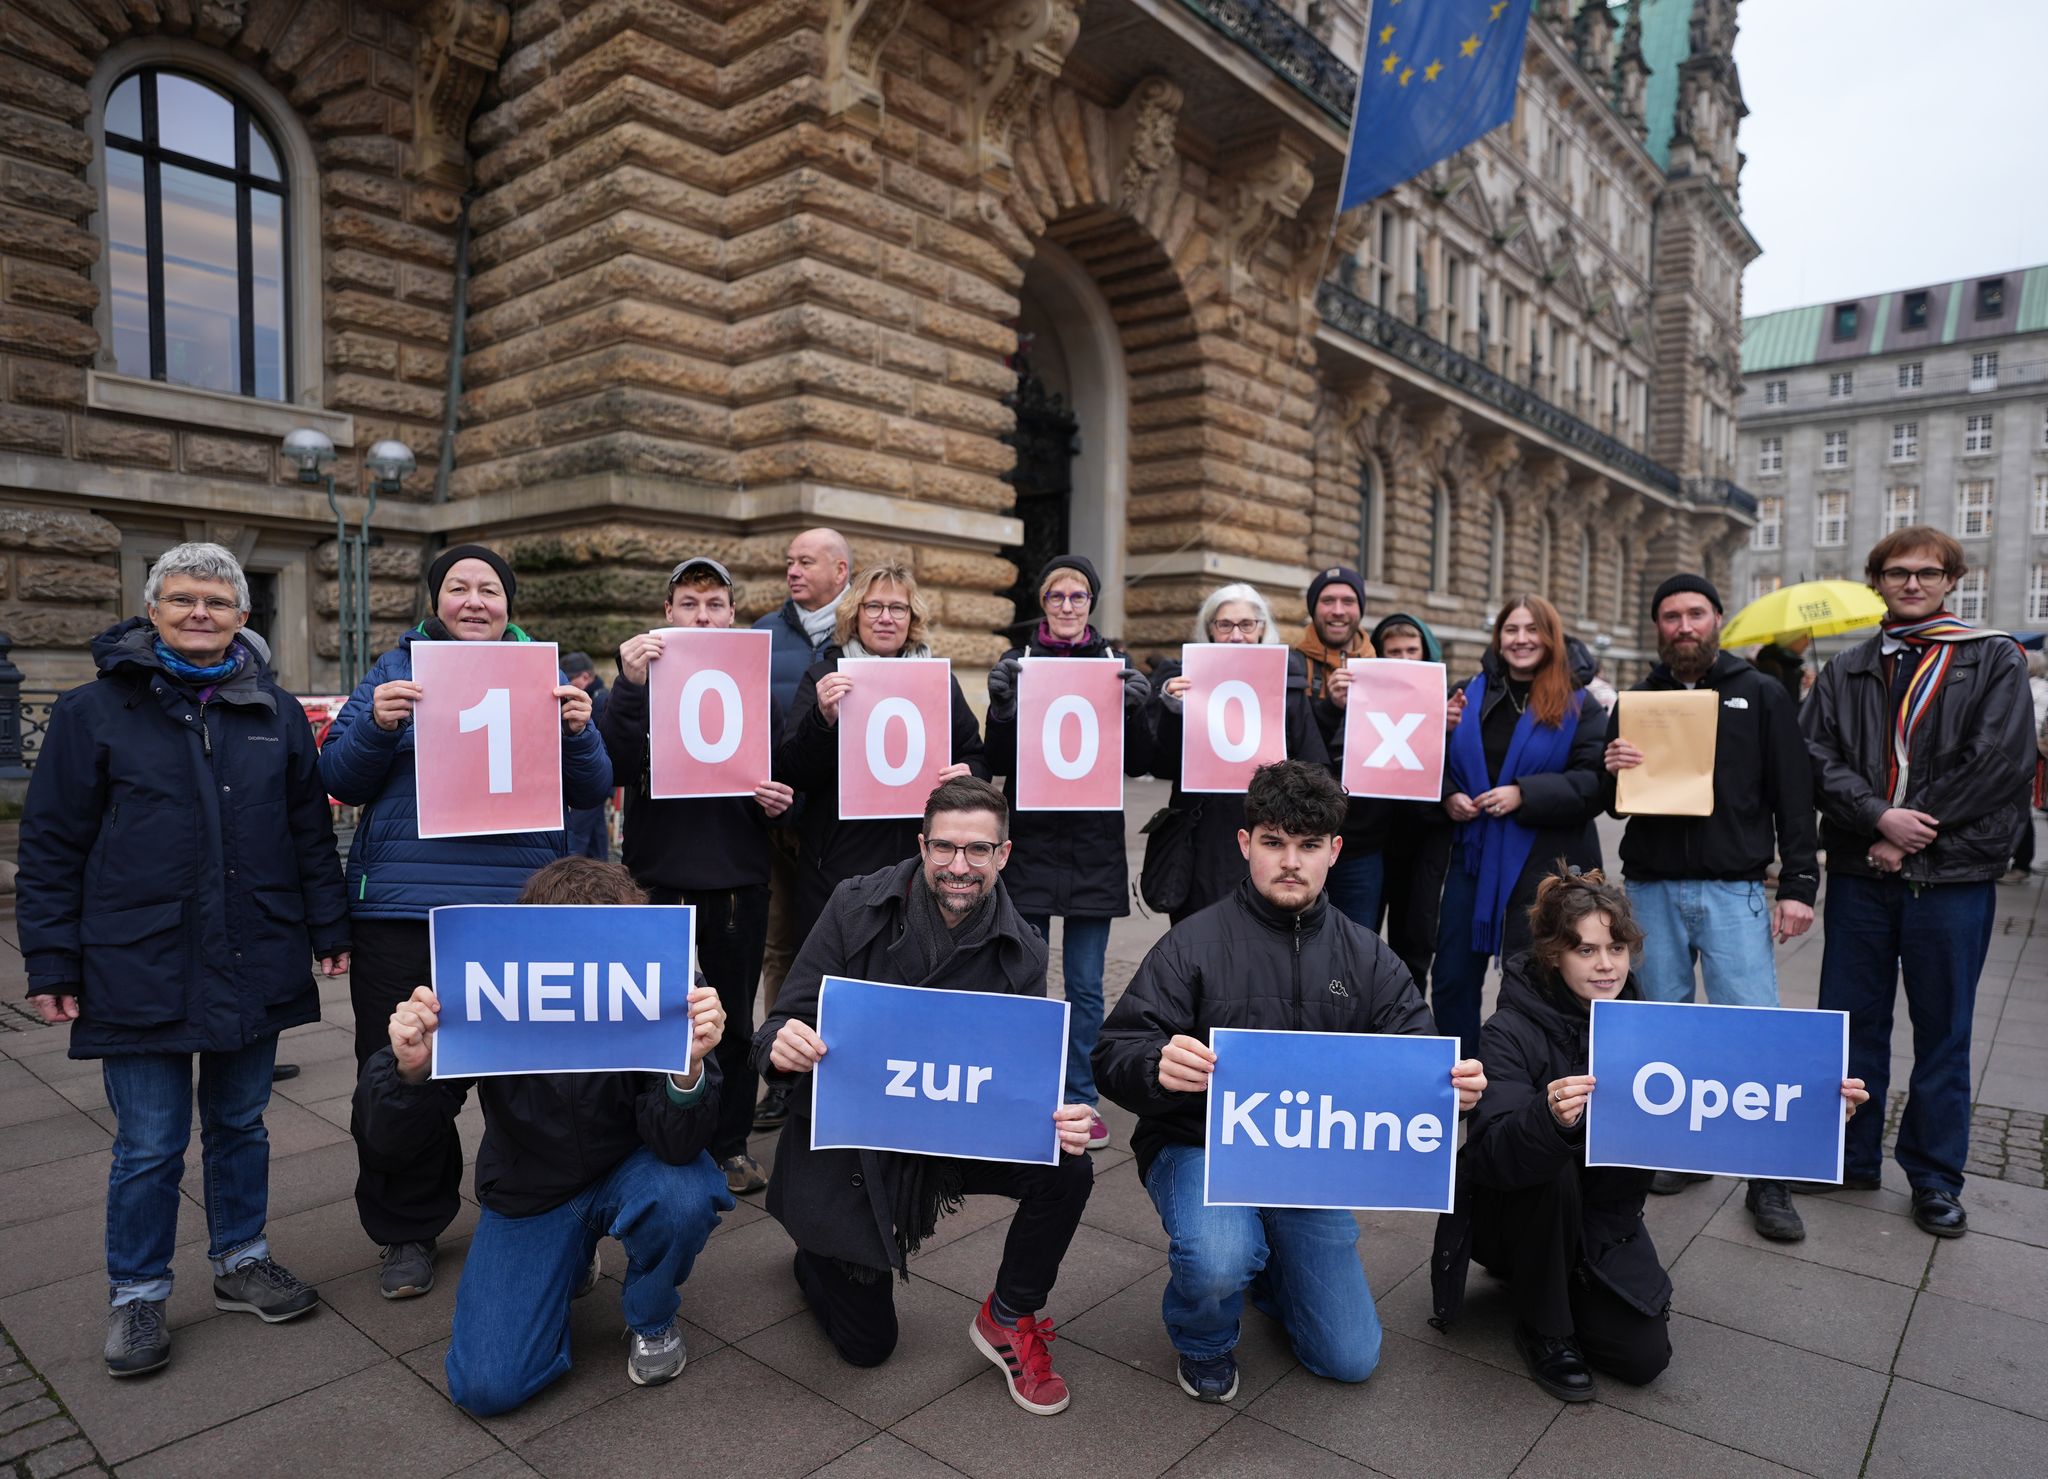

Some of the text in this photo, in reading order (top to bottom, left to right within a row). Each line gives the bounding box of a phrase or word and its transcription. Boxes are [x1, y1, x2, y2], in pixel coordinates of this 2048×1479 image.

[1798, 599, 1829, 611] FREE
[458, 688, 513, 795] 1
[678, 669, 744, 764] 0
[865, 696, 927, 787] 0
[1041, 694, 1100, 780] 0
[1206, 680, 1262, 763] 0
[465, 961, 661, 1022] NEIN
[885, 1059, 993, 1104] zur
[1632, 1061, 1802, 1131] Oper
[1221, 1090, 1443, 1153] Kühne
